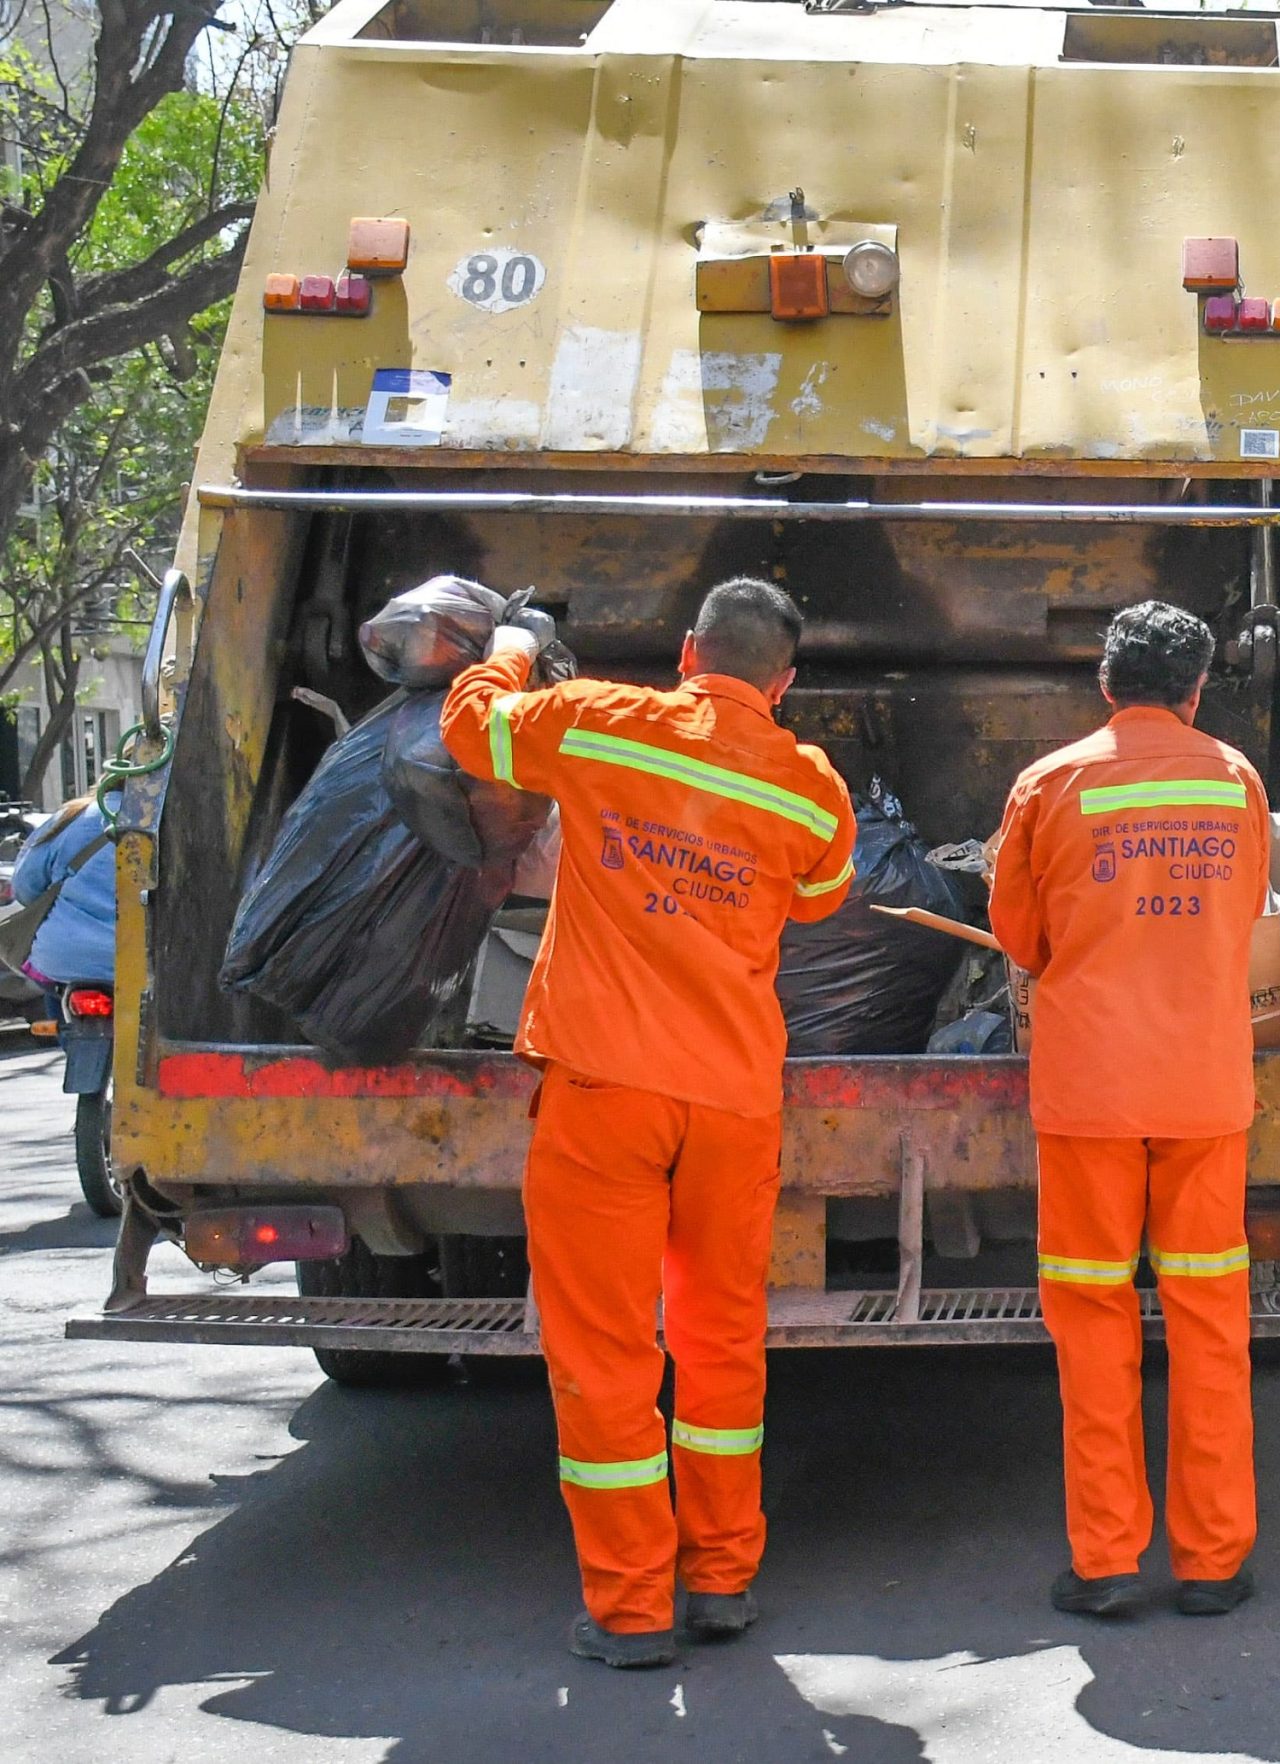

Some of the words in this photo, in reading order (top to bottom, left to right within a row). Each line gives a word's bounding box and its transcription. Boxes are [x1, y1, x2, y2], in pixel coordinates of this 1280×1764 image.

[462, 254, 536, 303] 80
[625, 816, 640, 831] DE
[642, 820, 704, 847] SERVICIOS
[706, 839, 758, 865] URBANOS
[1115, 822, 1129, 834] DE
[1132, 820, 1189, 833] SERVICIOS
[1191, 820, 1240, 834] URBANOS
[627, 835, 758, 887] SANTIAGO
[1121, 836, 1236, 859] SANTIAGO
[1168, 862, 1233, 881] CIUDAD
[672, 877, 751, 909] CIUDAD
[1135, 895, 1201, 916] 2023
